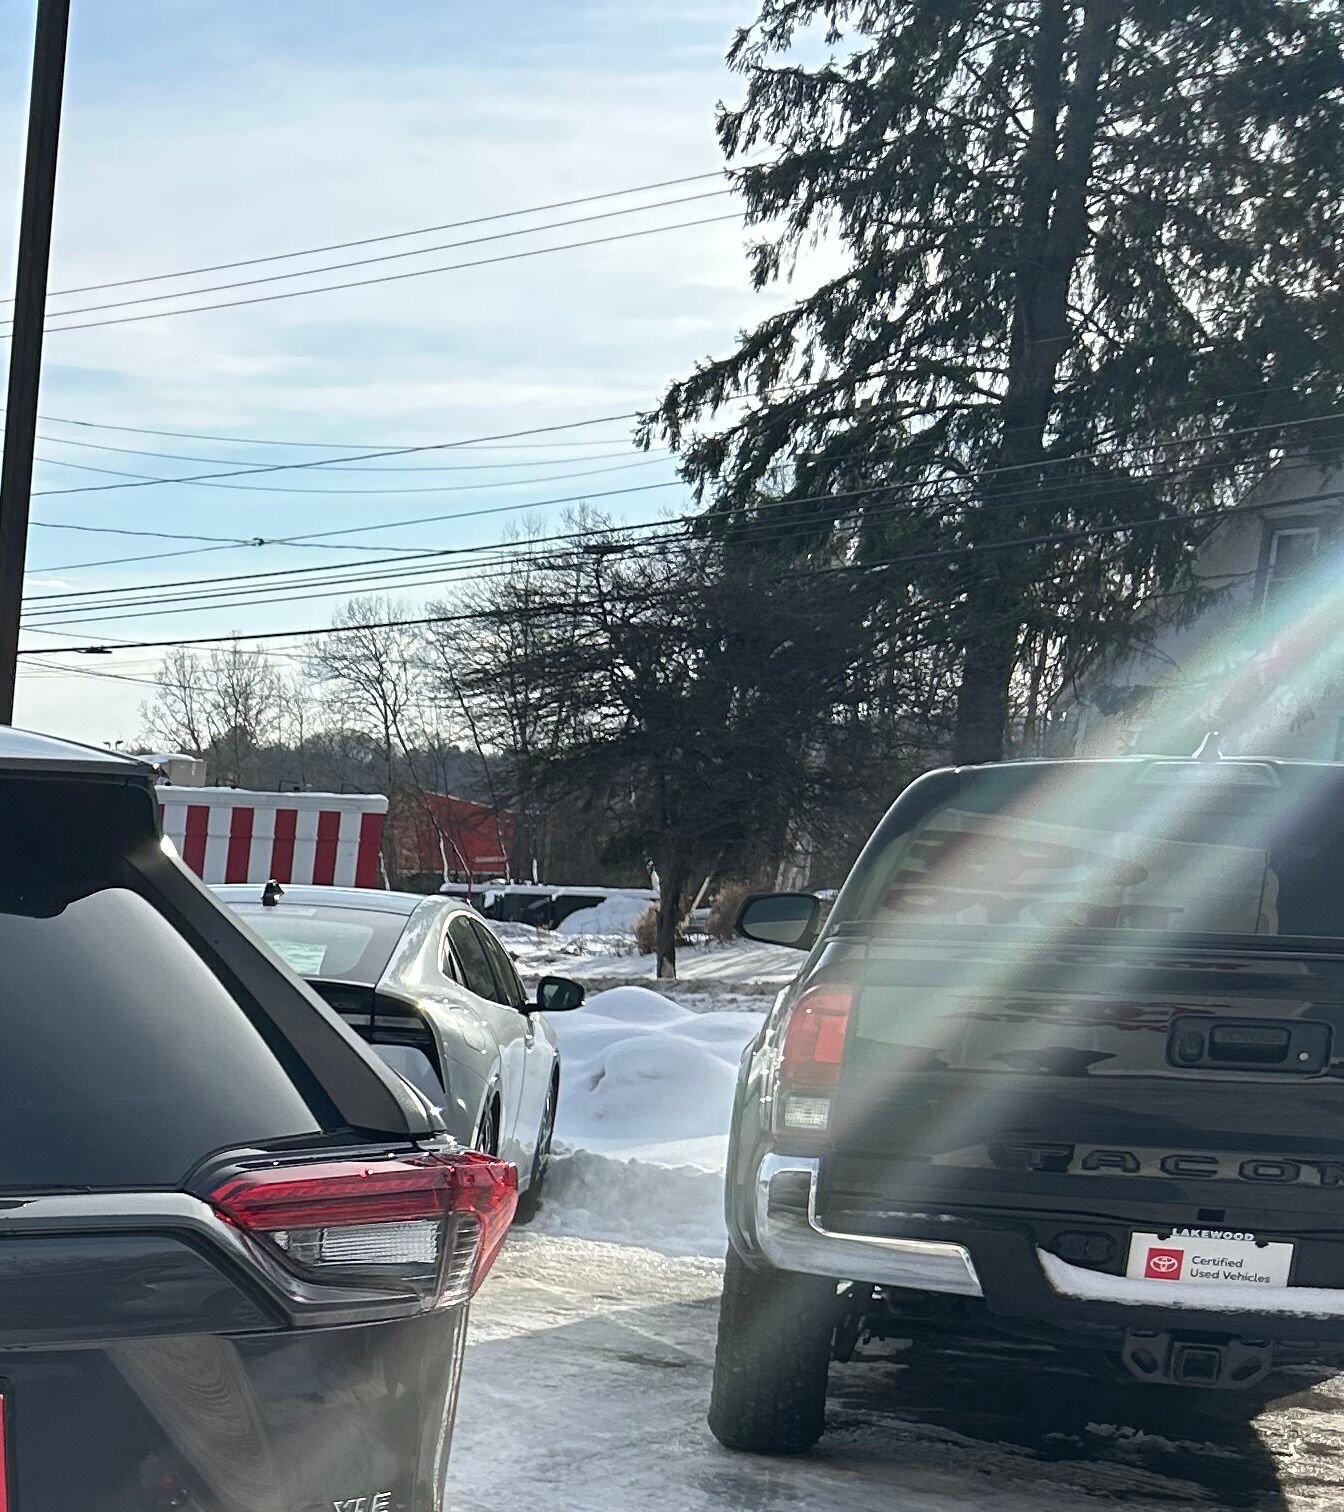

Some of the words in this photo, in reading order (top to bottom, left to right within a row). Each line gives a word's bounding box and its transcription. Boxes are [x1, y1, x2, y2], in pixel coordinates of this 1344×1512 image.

[1171, 1228, 1255, 1241] LAKEWOOD
[1191, 1255, 1243, 1268] Certified
[1190, 1268, 1219, 1279] Used
[1222, 1271, 1271, 1283] Vehicles
